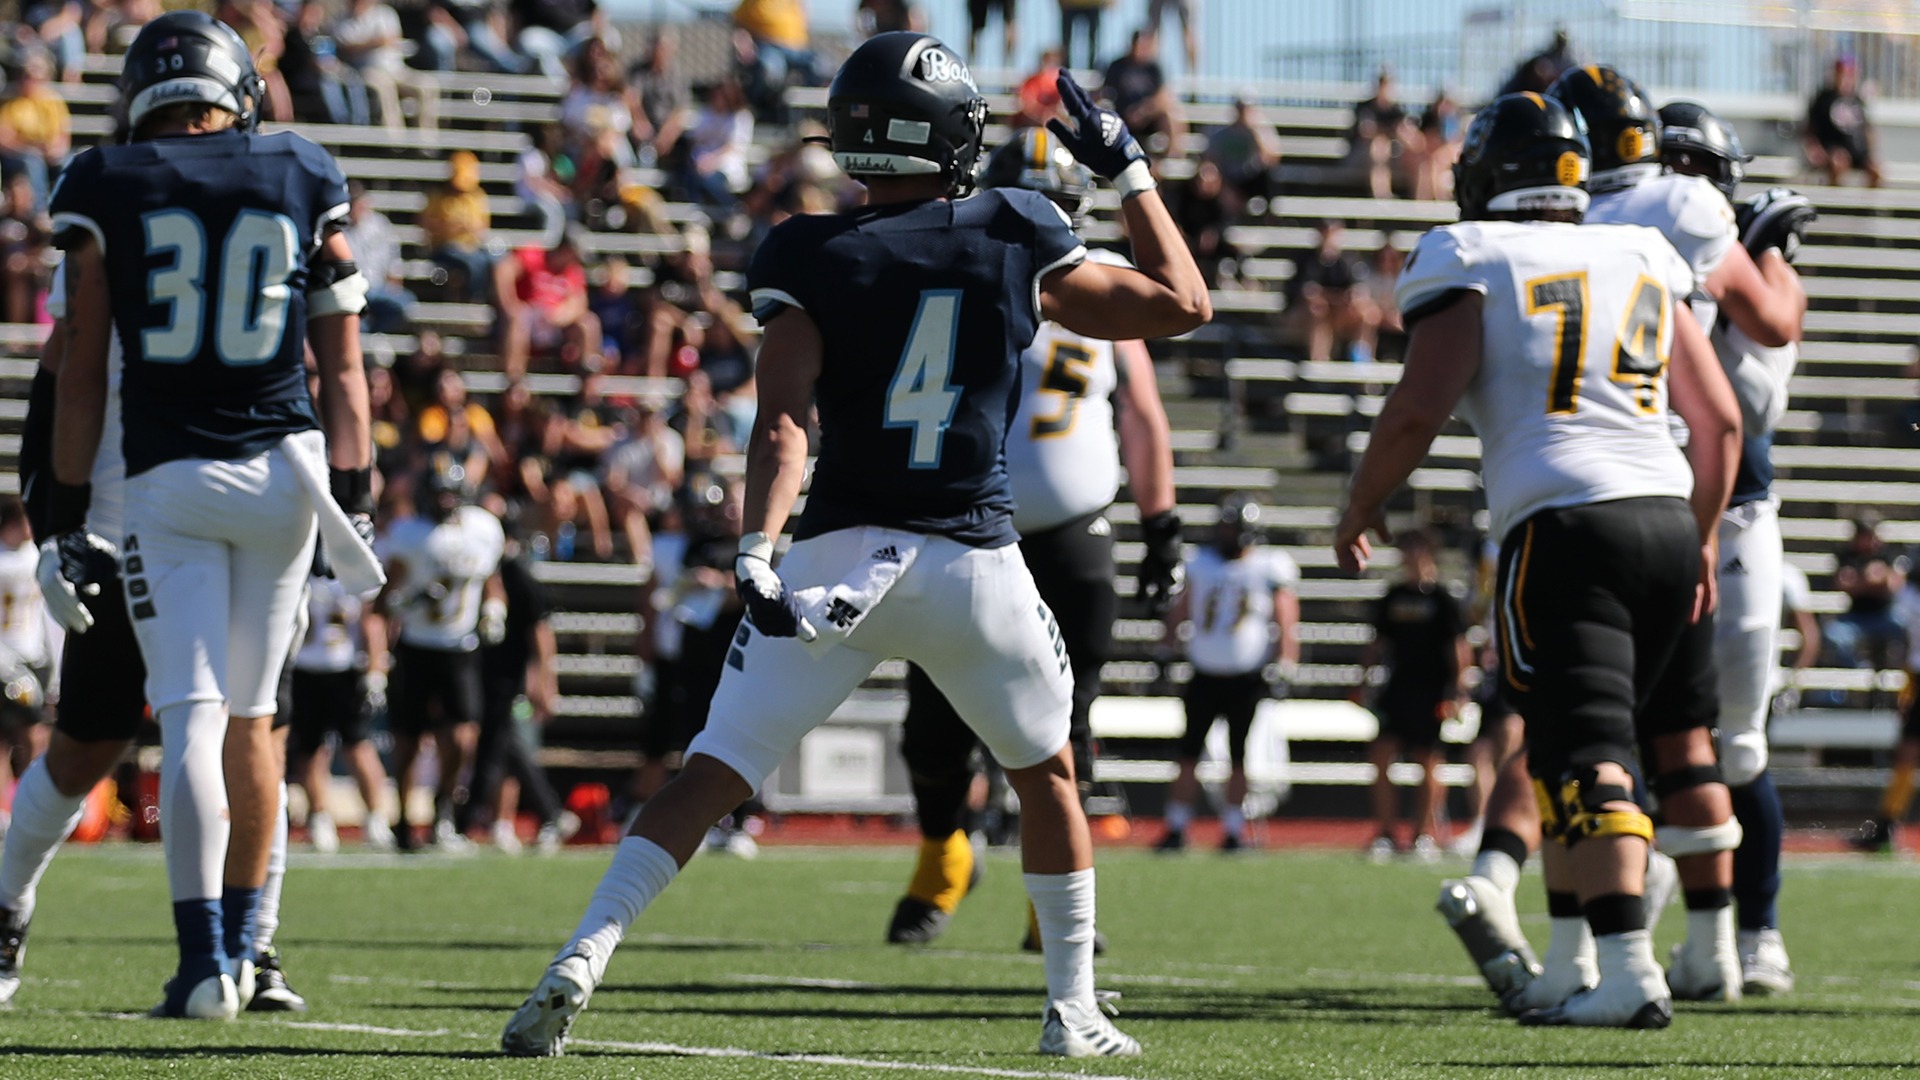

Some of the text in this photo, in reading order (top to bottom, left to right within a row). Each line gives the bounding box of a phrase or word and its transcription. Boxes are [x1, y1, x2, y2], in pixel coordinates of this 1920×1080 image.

[155, 53, 184, 74] 30
[862, 128, 874, 144] 4
[140, 207, 300, 367] 30
[1524, 270, 1670, 416] 74
[882, 288, 965, 470] 4
[1029, 339, 1098, 441] 5
